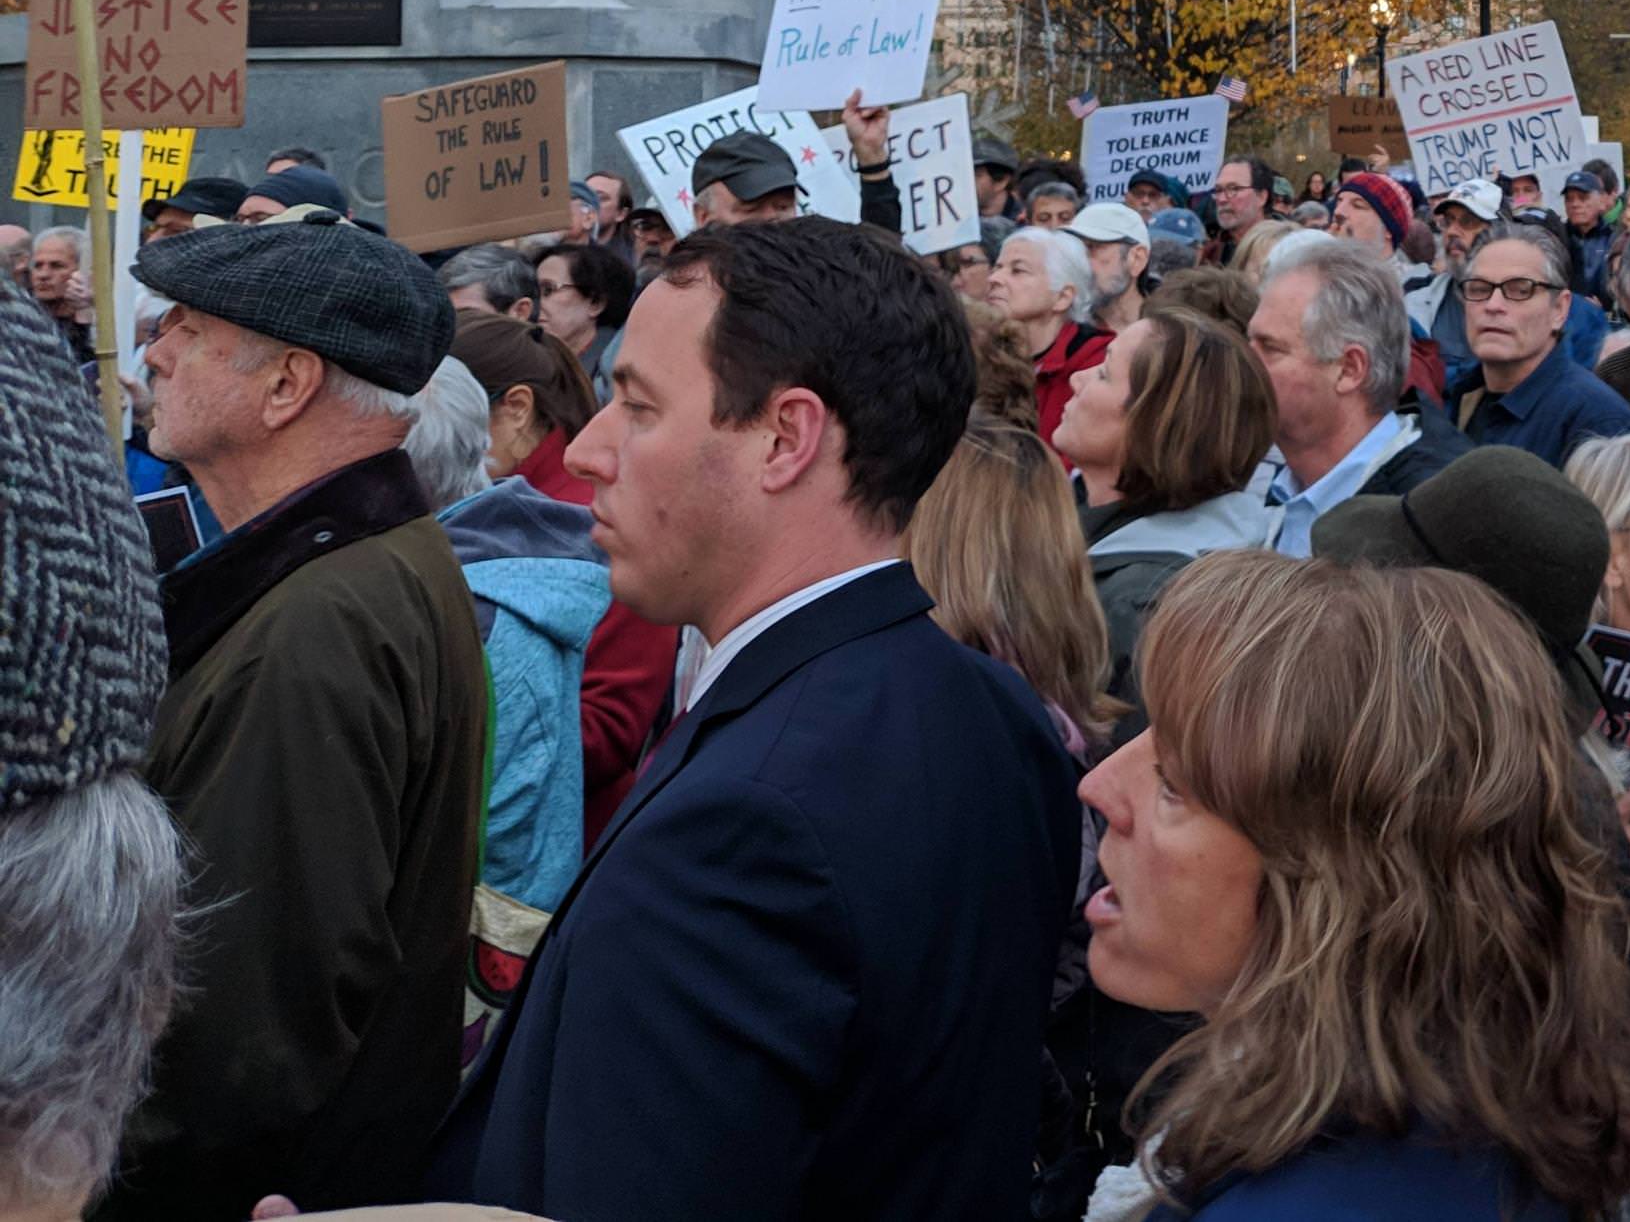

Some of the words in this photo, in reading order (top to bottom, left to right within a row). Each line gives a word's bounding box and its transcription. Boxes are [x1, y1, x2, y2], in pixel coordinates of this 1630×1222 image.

[103, 34, 161, 74] NO
[776, 23, 830, 67] Rule
[837, 24, 863, 57] of
[868, 13, 924, 56] Law!
[1400, 64, 1424, 93] A
[1425, 54, 1473, 84] RED
[1478, 33, 1545, 71] LINE
[33, 68, 238, 116] FREEDOM
[415, 78, 537, 123] SAFEGUARD
[1418, 72, 1548, 117] CROSSED
[436, 125, 468, 154] THE
[482, 118, 521, 145] RULE
[1131, 107, 1189, 127] TRUTH
[1416, 123, 1498, 162] TRUMP
[1508, 109, 1562, 145] NOT
[1106, 128, 1209, 154] TOLERANCE
[1110, 150, 1200, 174] DECORUM
[1428, 150, 1498, 191] ABOVE
[1510, 136, 1571, 171] LAW
[425, 166, 456, 200] OF
